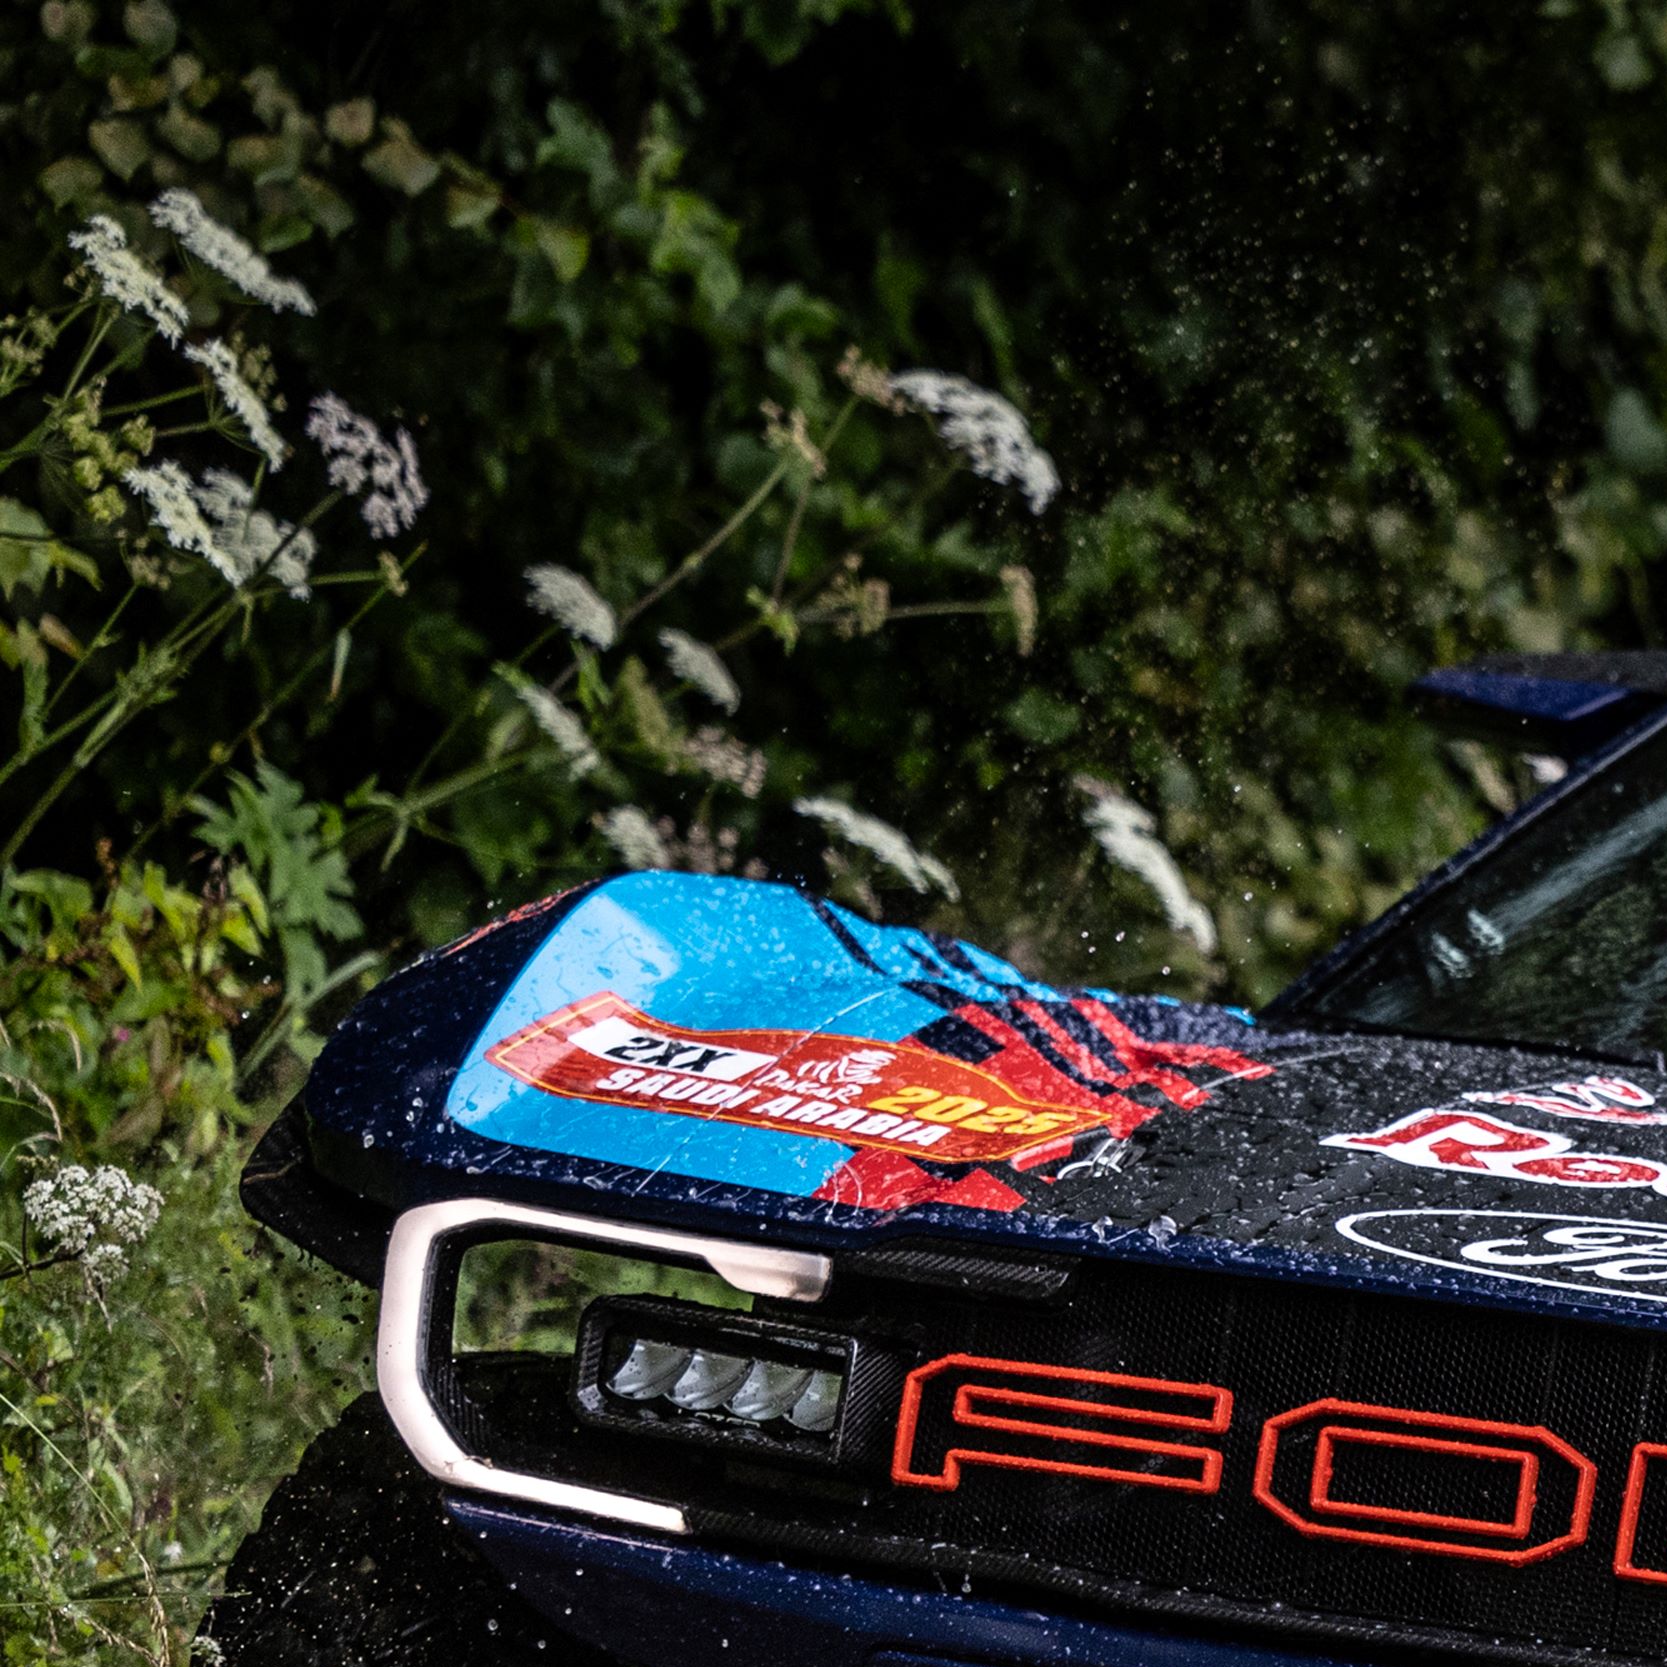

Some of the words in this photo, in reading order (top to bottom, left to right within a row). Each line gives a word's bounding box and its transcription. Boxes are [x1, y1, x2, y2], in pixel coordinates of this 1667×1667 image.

[602, 1036, 734, 1073] 2XX
[597, 1069, 760, 1108] SAUDI
[750, 1094, 952, 1147] ARABIA
[756, 1069, 864, 1105] DAKAR
[868, 1086, 1076, 1135] 2025
